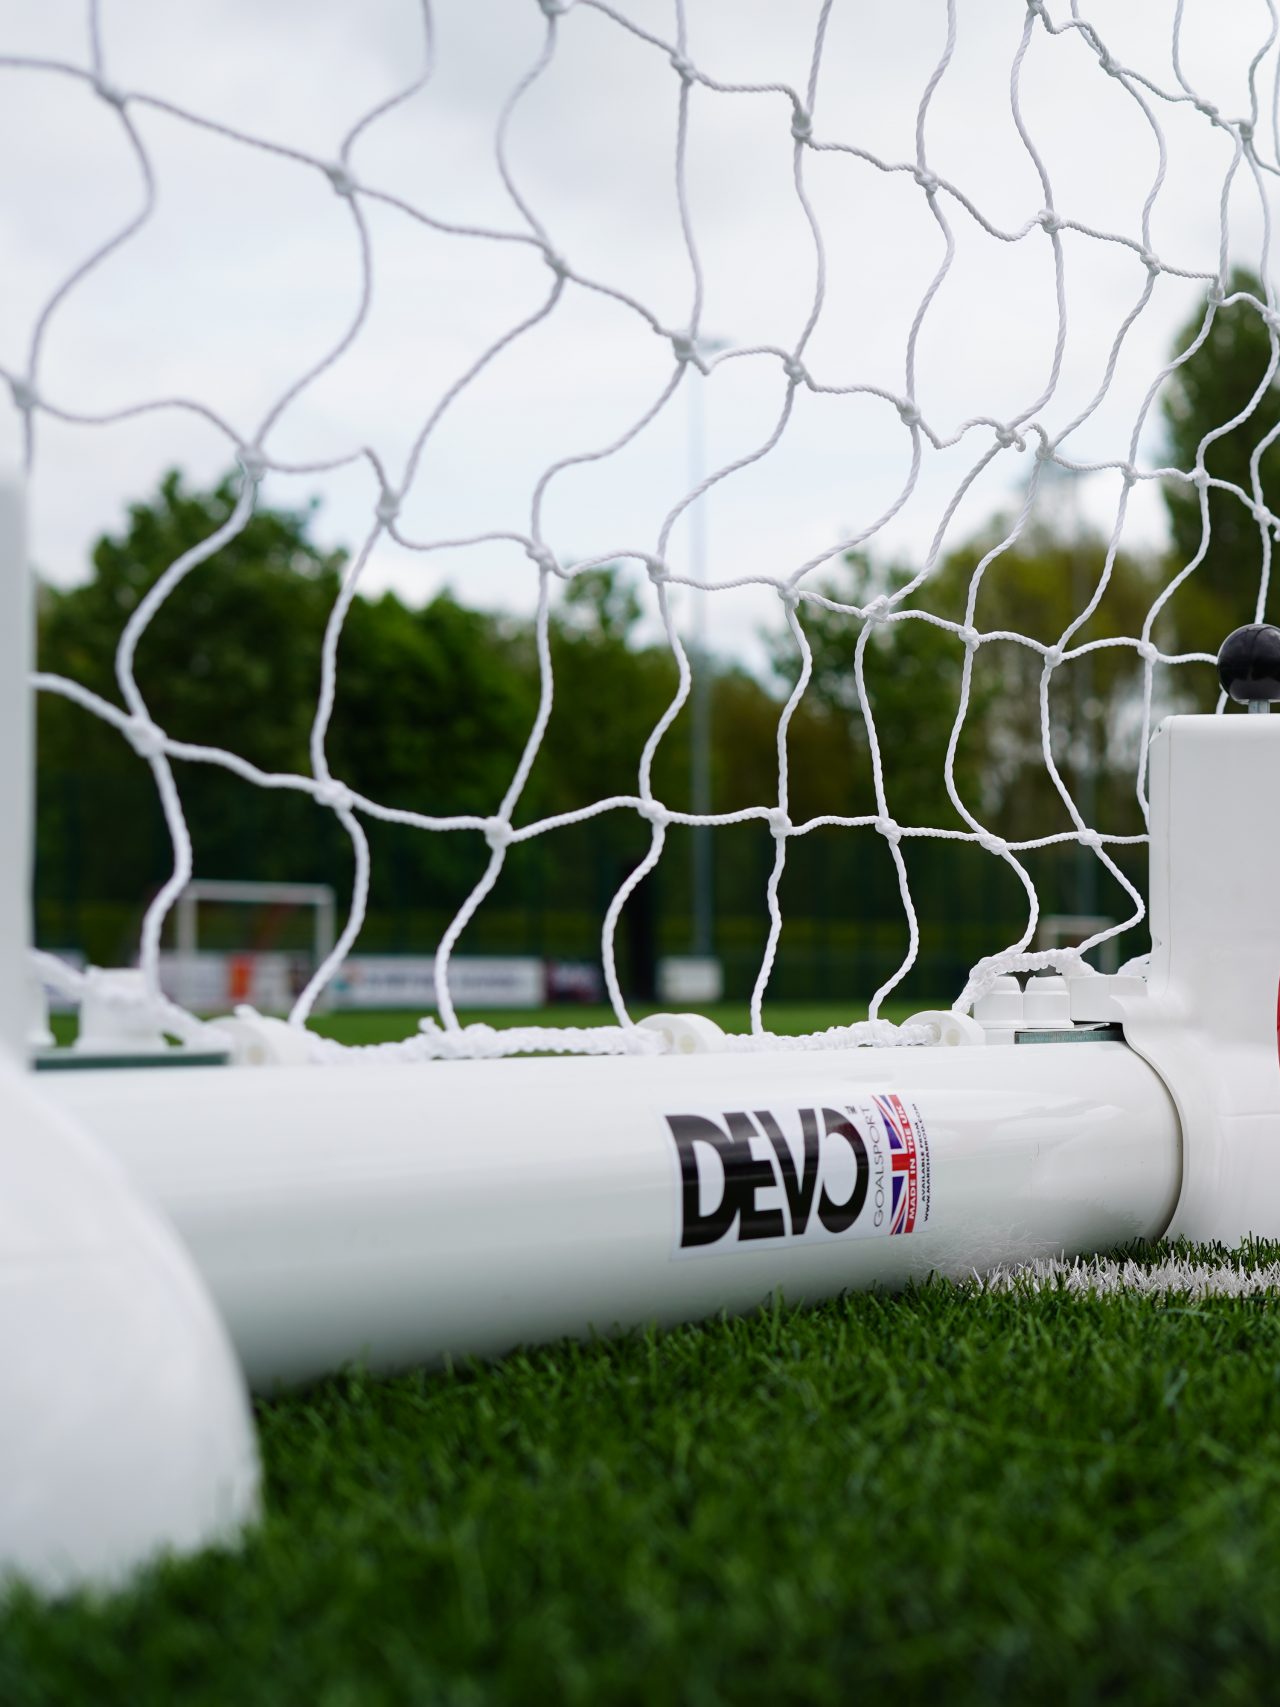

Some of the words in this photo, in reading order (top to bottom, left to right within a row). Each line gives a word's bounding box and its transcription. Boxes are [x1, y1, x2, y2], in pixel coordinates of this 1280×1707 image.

[896, 1104, 908, 1124] UK
[905, 1128, 915, 1154] THE
[665, 1107, 869, 1248] DEVO
[861, 1105, 884, 1227] GOALSPORT
[909, 1158, 916, 1175] IN
[908, 1180, 917, 1220] MADE
